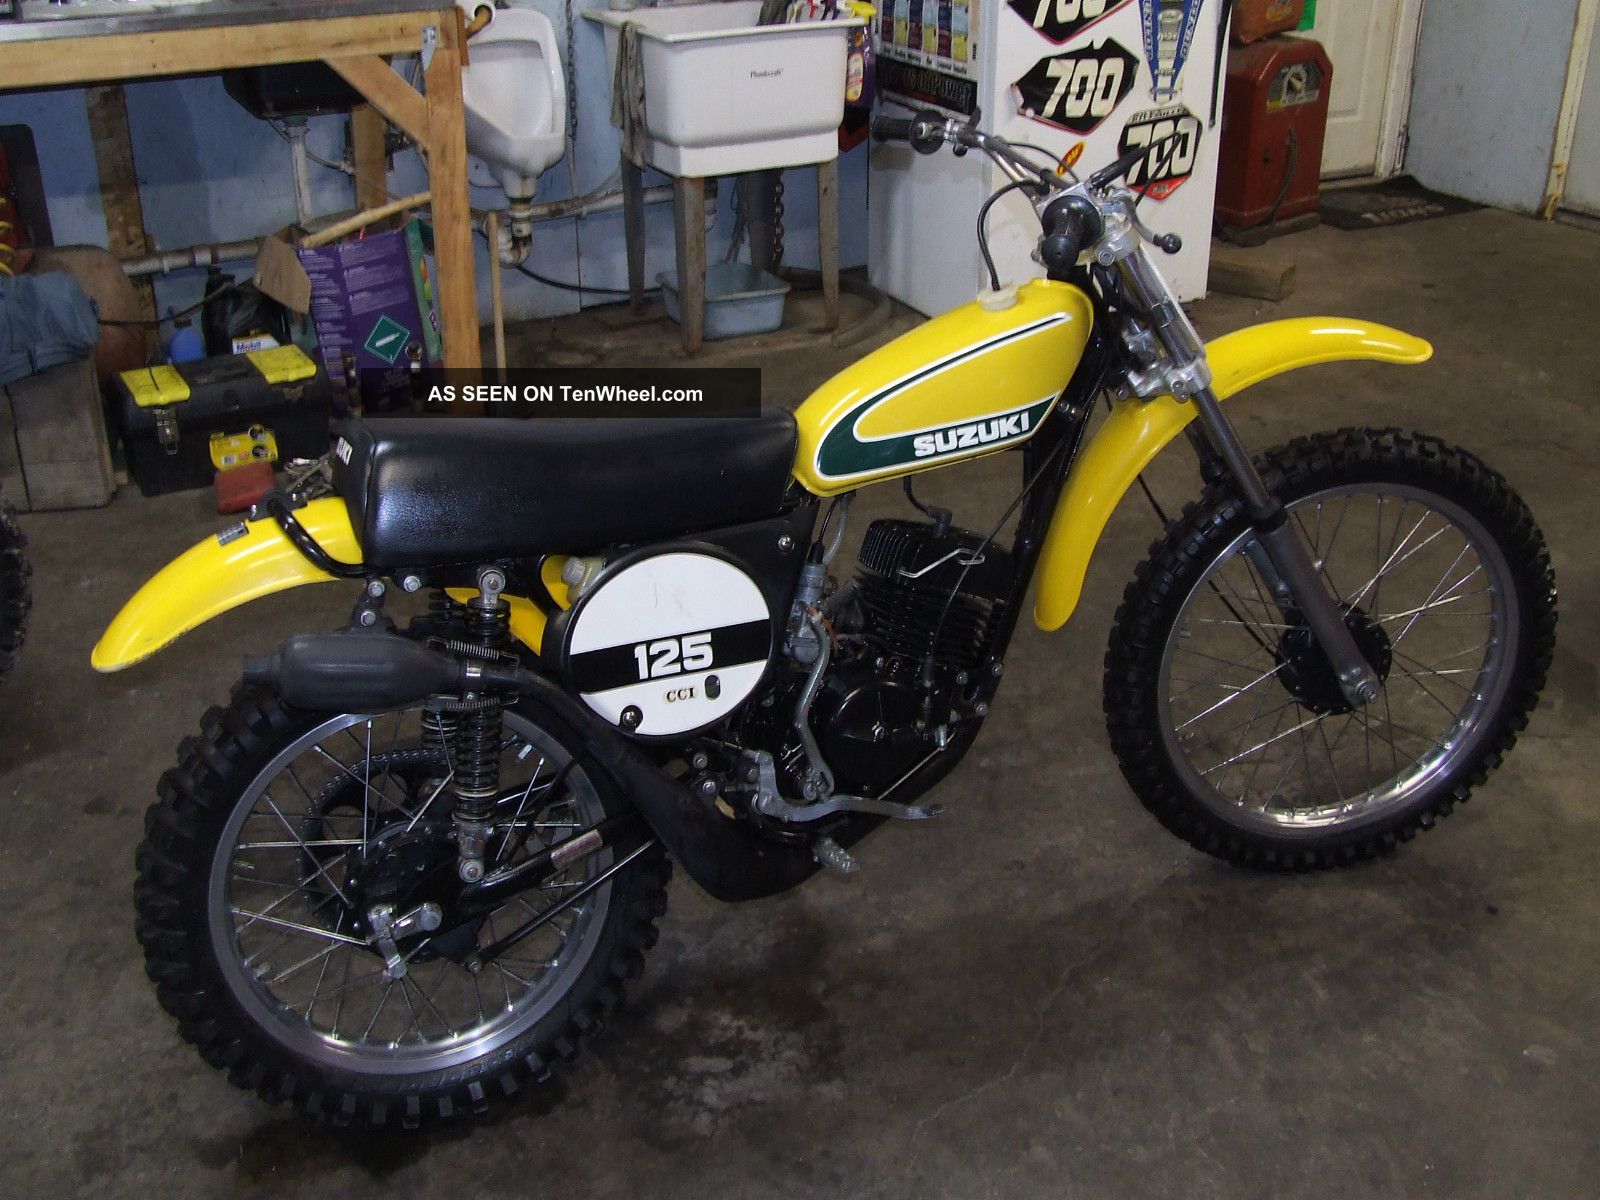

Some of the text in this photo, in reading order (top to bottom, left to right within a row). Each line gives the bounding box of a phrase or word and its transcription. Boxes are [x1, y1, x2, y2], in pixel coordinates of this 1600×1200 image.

[1041, 57, 1125, 118] 700
[1126, 116, 1199, 186] 700
[913, 411, 1030, 457] SUZUKI
[634, 632, 714, 680] 125
[666, 687, 695, 702] CCI
